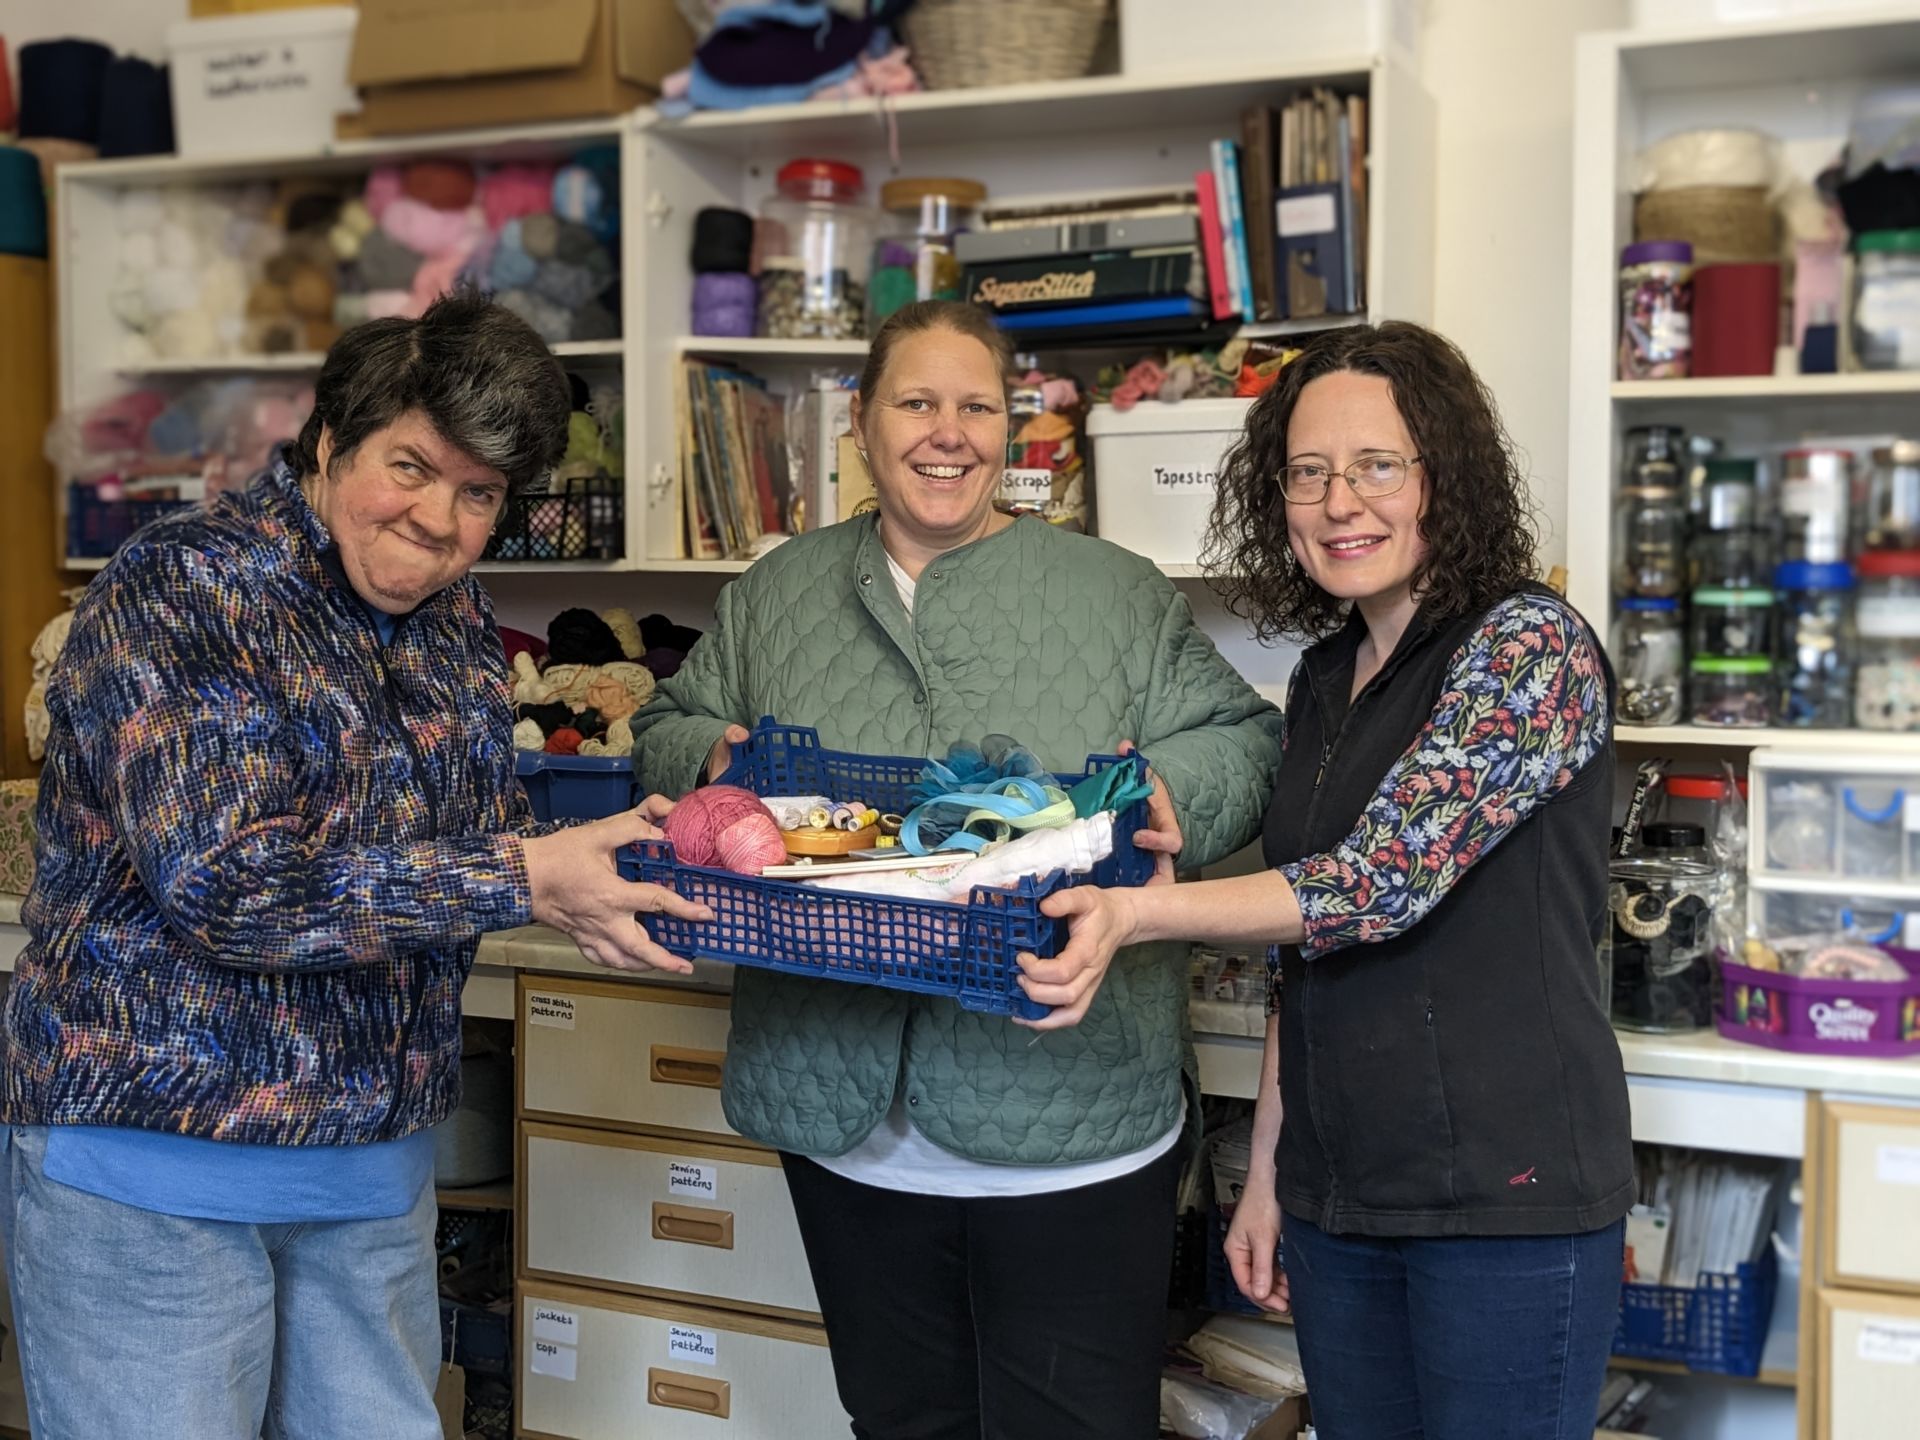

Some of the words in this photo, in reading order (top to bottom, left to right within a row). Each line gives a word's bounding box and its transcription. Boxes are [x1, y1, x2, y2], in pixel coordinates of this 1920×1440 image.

[1003, 472, 1051, 493] Scraps
[1154, 467, 1220, 489] Tapestry
[1634, 786, 1646, 802] The
[552, 999, 574, 1011] stitch
[531, 1006, 573, 1020] patterns
[671, 1176, 713, 1191] patterns
[535, 1308, 573, 1325] jackets
[536, 1342, 557, 1356] tops
[671, 1340, 715, 1355] patterns
